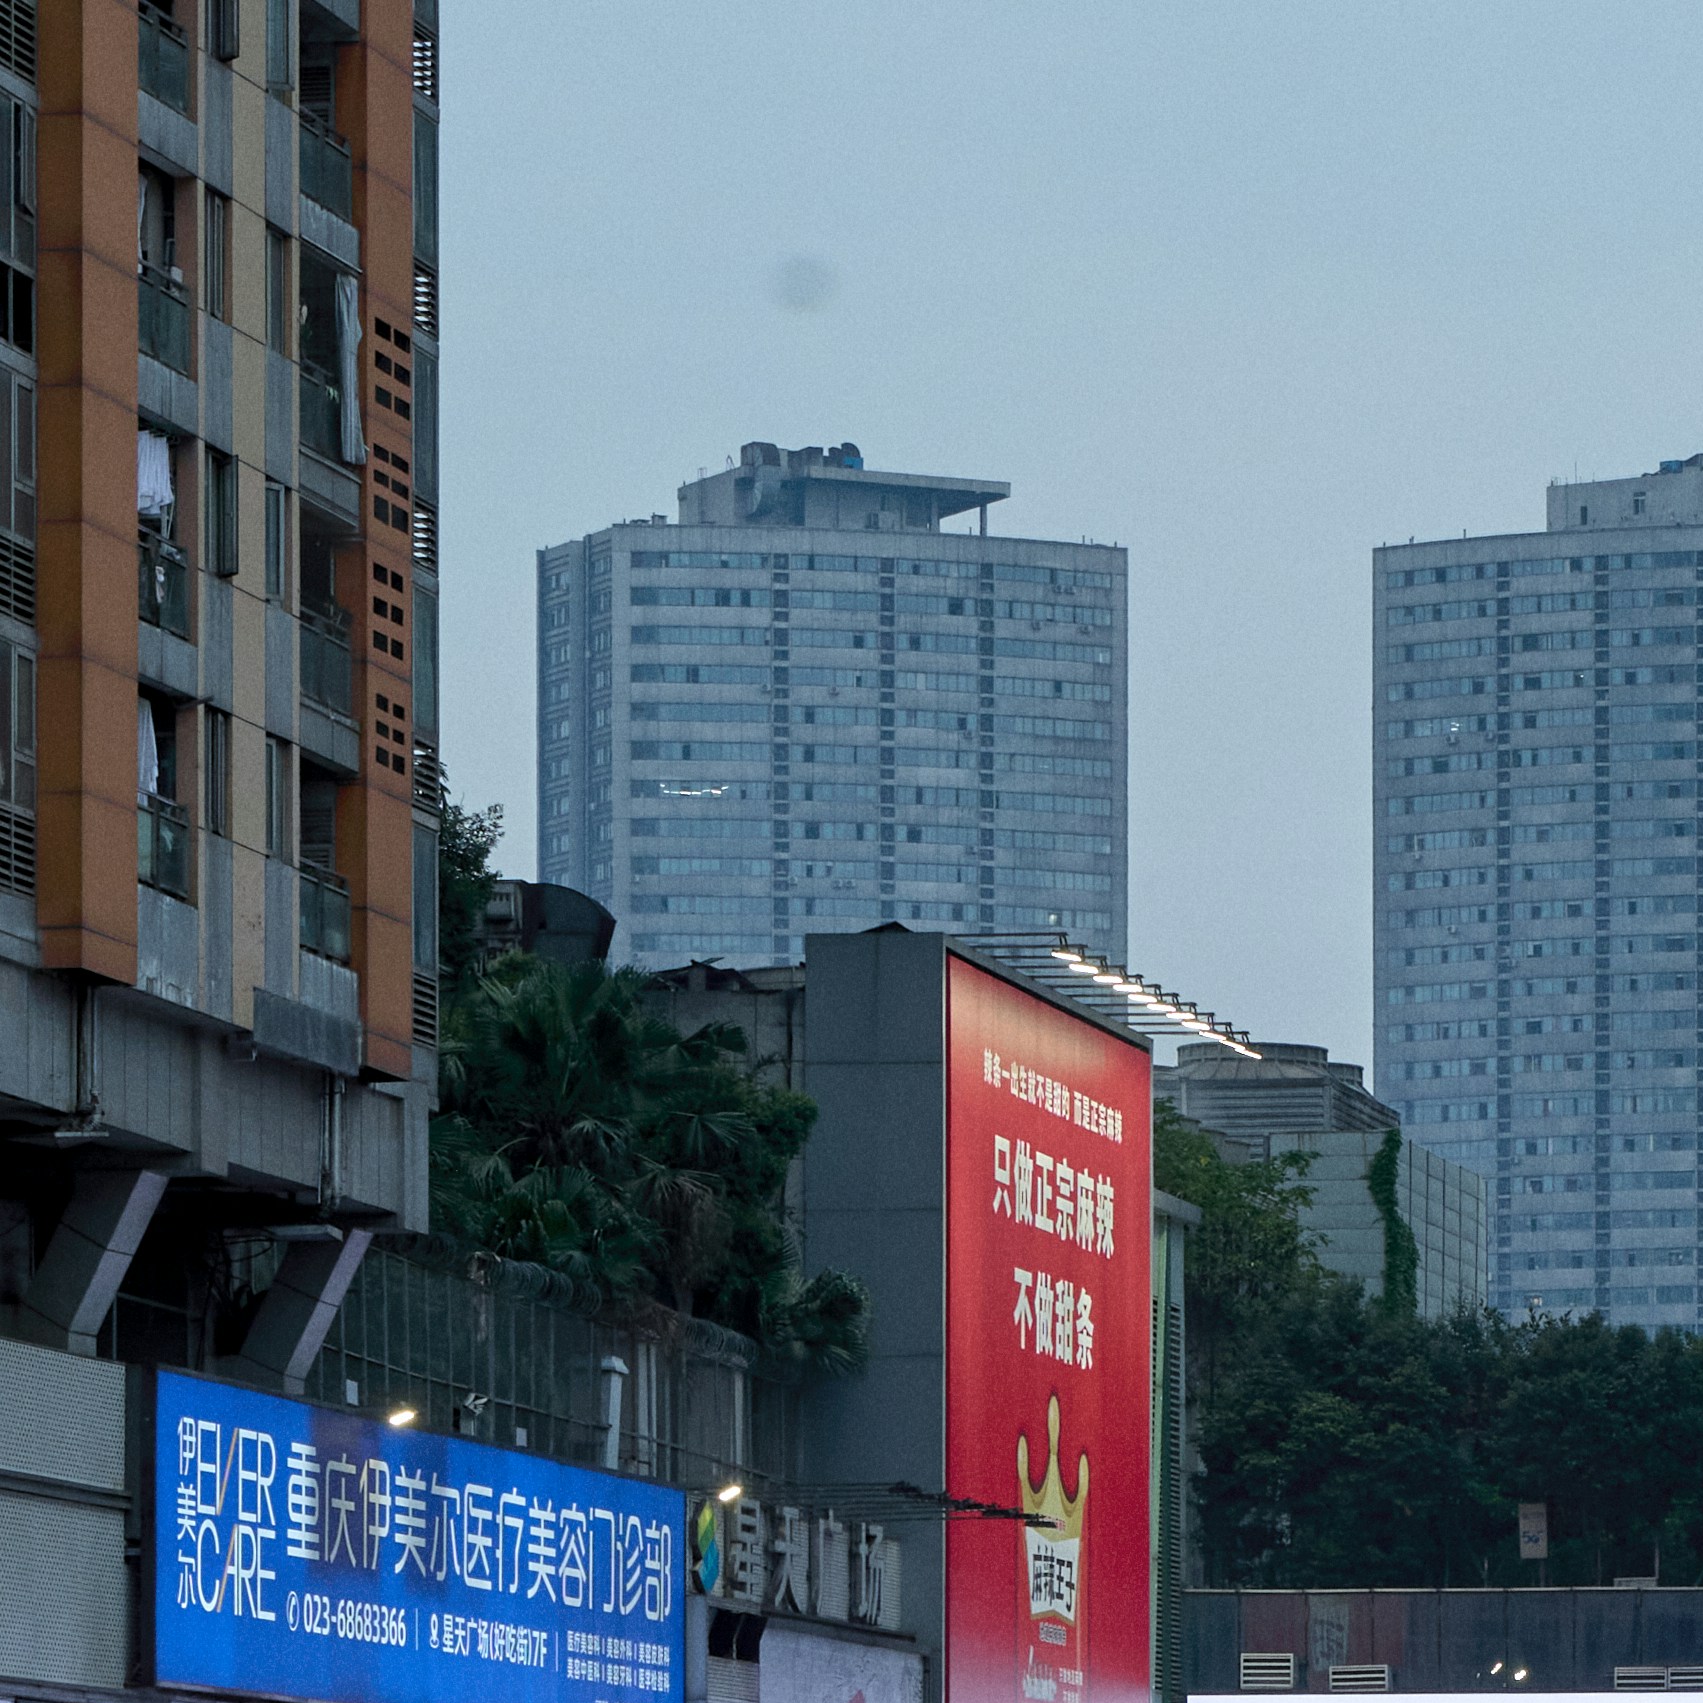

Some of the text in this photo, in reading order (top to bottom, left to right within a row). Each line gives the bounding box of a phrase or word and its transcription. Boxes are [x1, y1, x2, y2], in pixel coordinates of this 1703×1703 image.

[983, 1047, 1123, 1145] 辣条一出生就不是甜的 而是正宗麻辣
[993, 1134, 1114, 1260] 只做正宗麻辣
[1013, 1267, 1094, 1370] 不做甜条
[177, 1417, 196, 1609] 伊美尔
[287, 1442, 672, 1623] 重庆伊美尔医疗美容门诊部
[729, 1498, 886, 1628] 星天广场
[197, 1519, 276, 1622] CARE
[303, 1593, 407, 1648] 023-68683366
[1031, 1545, 1075, 1612] 麻辣王子
[442, 1613, 548, 1668] 星天广场(好吃街)7F
[566, 1630, 670, 1667] 医疗美容科 美容外科 美容皮肤科
[566, 1657, 601, 1683] 美容中医科
[606, 1663, 633, 1687] 美容牙科
